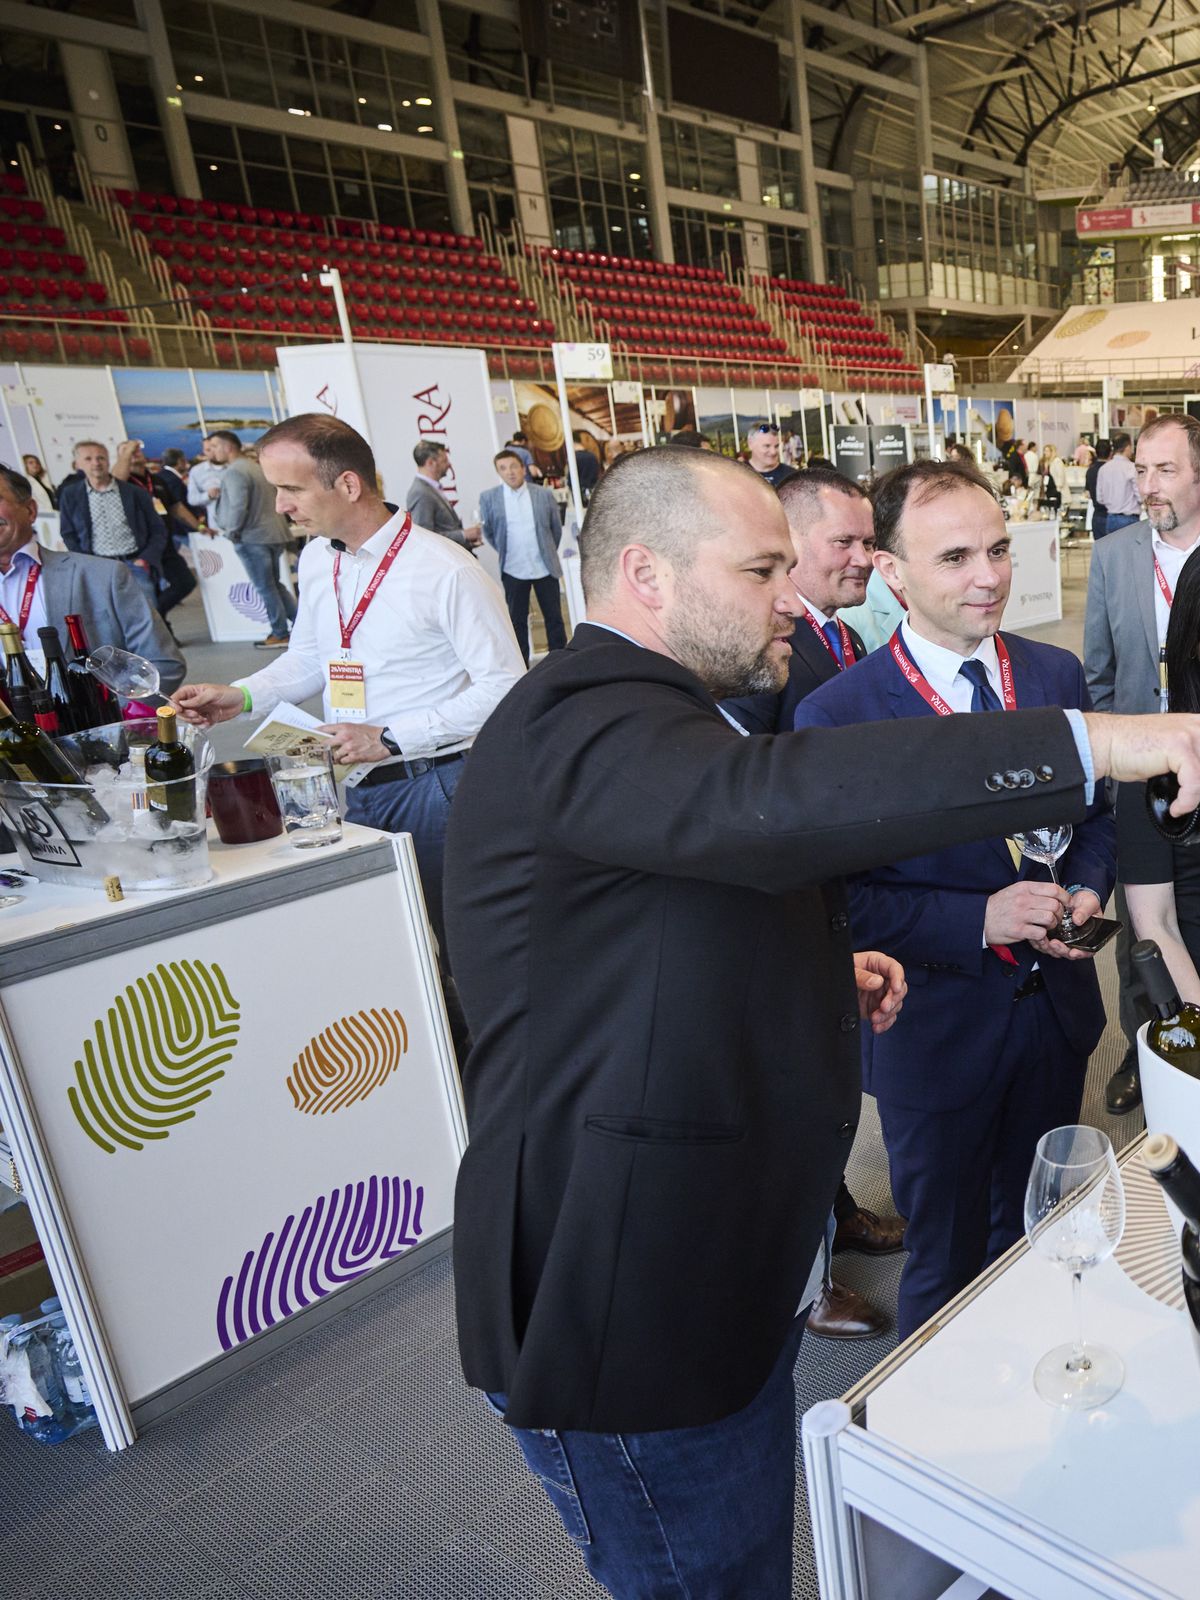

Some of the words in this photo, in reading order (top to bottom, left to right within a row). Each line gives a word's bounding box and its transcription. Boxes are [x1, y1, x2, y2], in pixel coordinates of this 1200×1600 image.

[587, 347, 606, 361] 59
[893, 643, 911, 671] VINISTRA
[1002, 658, 1012, 693] VINISTRA
[931, 694, 951, 716] ISTRA
